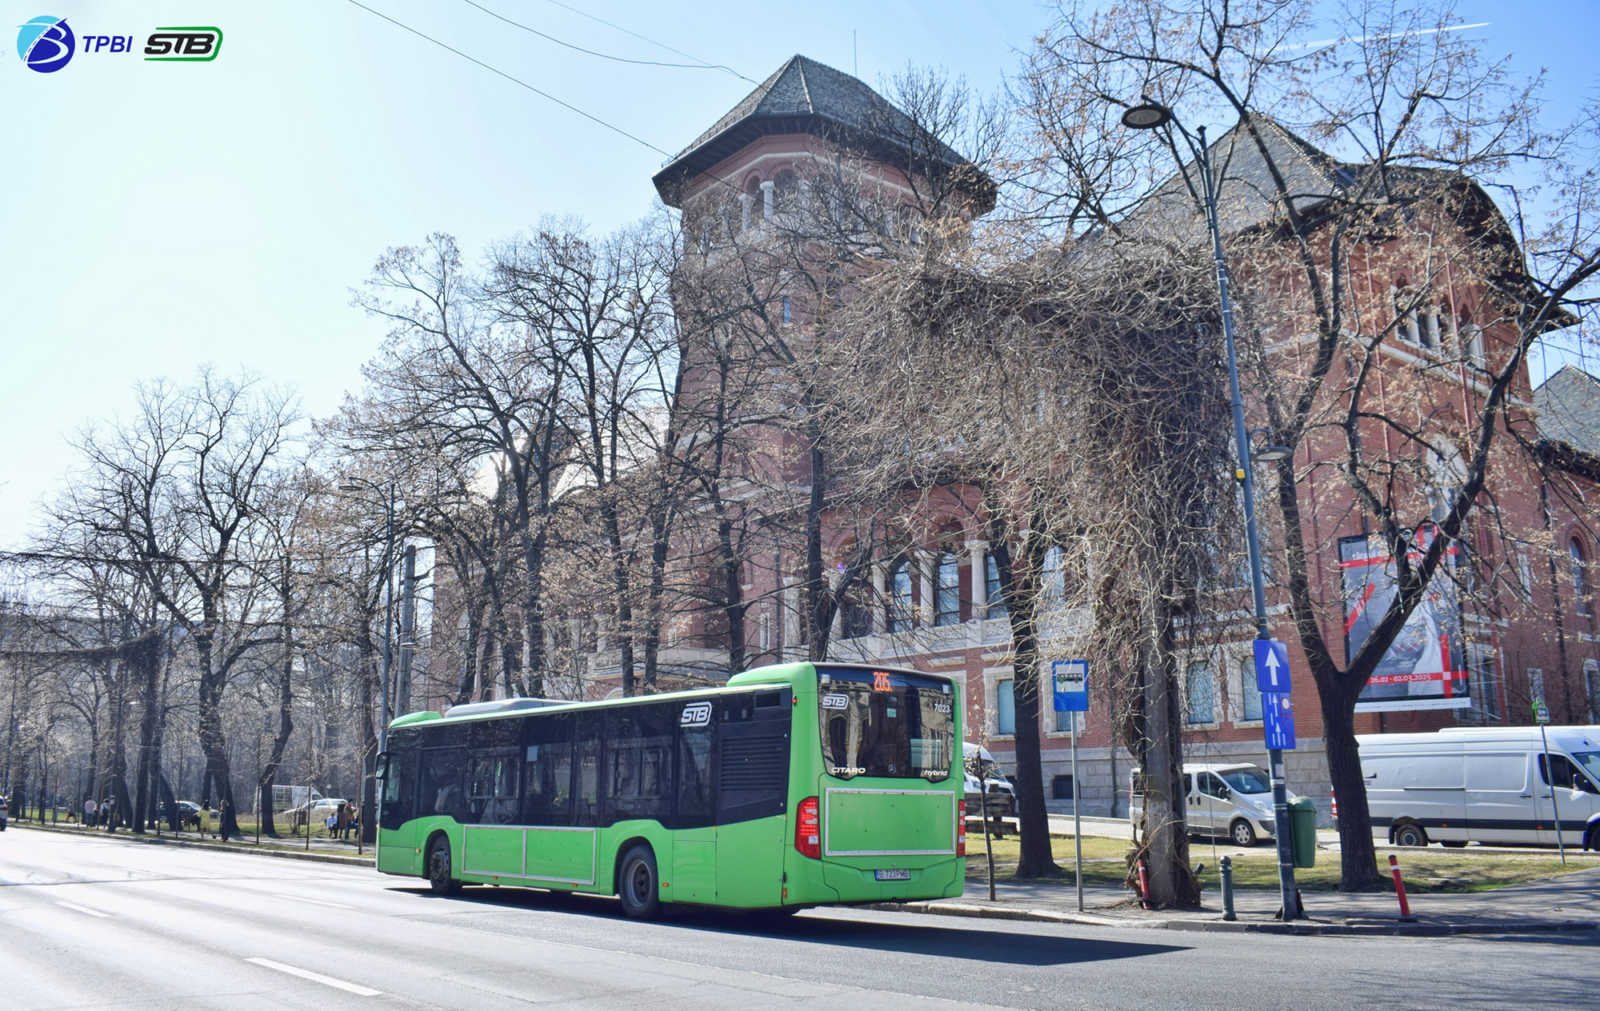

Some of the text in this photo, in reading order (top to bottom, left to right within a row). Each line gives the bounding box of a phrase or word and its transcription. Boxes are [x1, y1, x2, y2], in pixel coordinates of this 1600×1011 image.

[1370, 676, 1388, 684] 26.02
[1393, 674, 1431, 683] 02.03.2025
[822, 696, 846, 707] STB
[934, 703, 950, 713] 7023
[681, 706, 709, 723] STB
[831, 766, 866, 774] CITARO
[924, 769, 948, 777] hybrid
